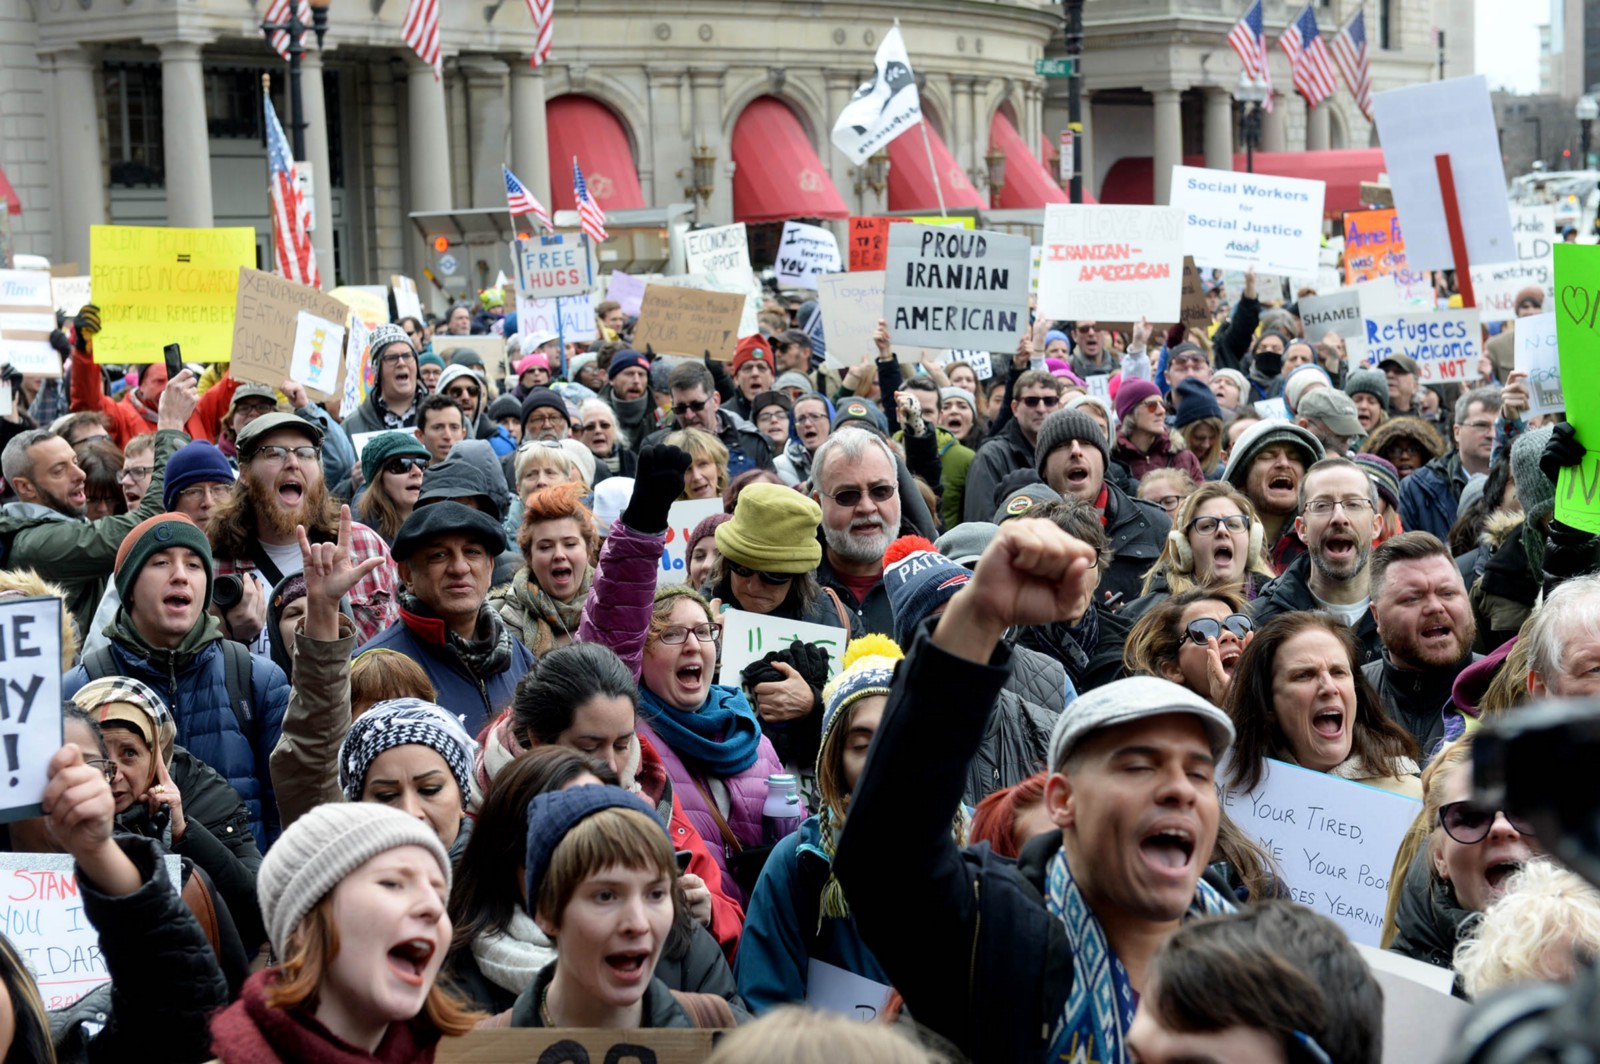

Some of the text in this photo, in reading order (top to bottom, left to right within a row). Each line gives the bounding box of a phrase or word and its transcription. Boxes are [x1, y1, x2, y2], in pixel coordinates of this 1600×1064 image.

[1187, 178, 1310, 202] Social Workers
[1047, 209, 1078, 241] I
[1083, 208, 1142, 241] LOVE
[1187, 214, 1303, 238] Social Justice
[920, 230, 987, 259] PROUD
[525, 249, 576, 270] FREE
[780, 257, 807, 274] YOU
[93, 264, 152, 294] PROFILES
[157, 266, 172, 292] IN
[530, 268, 581, 289] HUGS
[906, 261, 1009, 291] IRANIAN
[1078, 261, 1171, 283] AMERICAN
[1492, 265, 1548, 284] watching
[242, 271, 320, 310] XENOPHOBIA
[136, 303, 160, 323] WILL
[242, 293, 293, 340] EAT MY
[320, 299, 347, 323] CAN
[552, 310, 596, 334] WALL
[894, 305, 1018, 333] AMERICAN
[1302, 306, 1361, 327] SHAME!
[1365, 318, 1468, 345] Refugees
[235, 325, 289, 370] SHORTS
[1403, 340, 1478, 361] welcome.
[1438, 358, 1468, 380] NOT
[1249, 790, 1296, 825] YOUR
[1307, 805, 1365, 845] TIRED,
[1259, 836, 1284, 862] ME
[1303, 847, 1348, 881] YOUR
[0, 904, 43, 937] YOU
